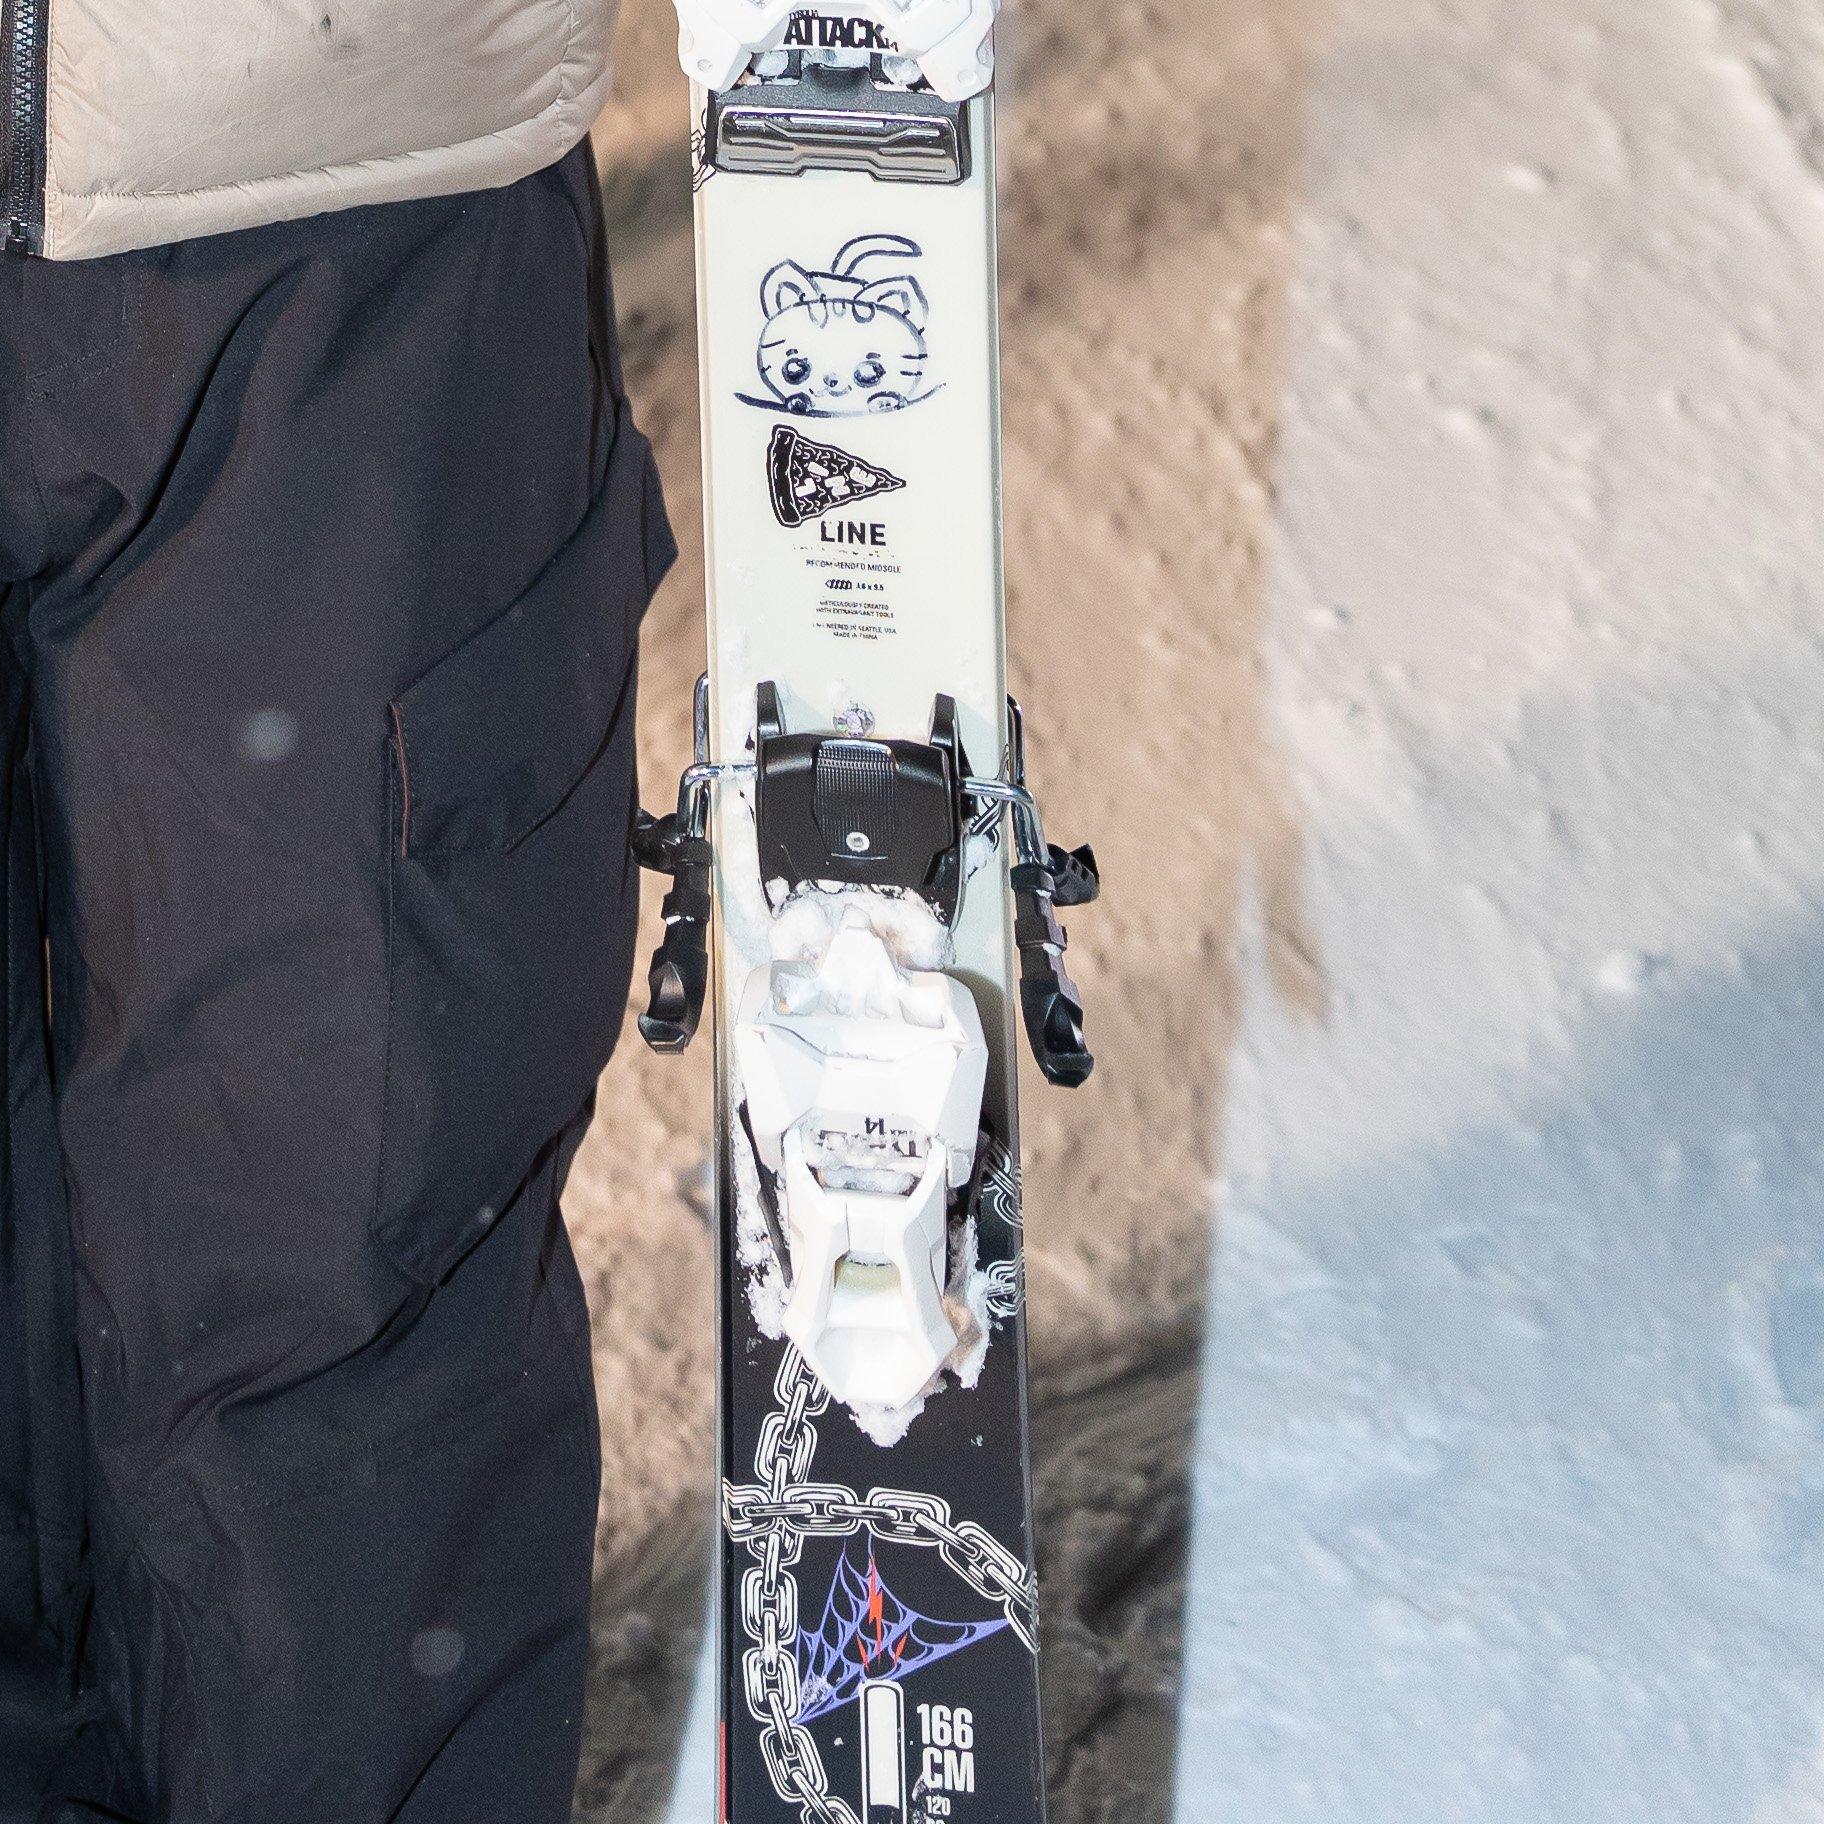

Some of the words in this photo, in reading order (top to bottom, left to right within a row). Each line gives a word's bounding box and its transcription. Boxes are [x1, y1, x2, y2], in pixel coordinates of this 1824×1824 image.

[782, 16, 890, 50] ATTACK
[820, 520, 887, 547] LINE
[916, 1703, 974, 1750] 166
[922, 1746, 975, 1793] CM
[926, 1795, 951, 1817] 120
